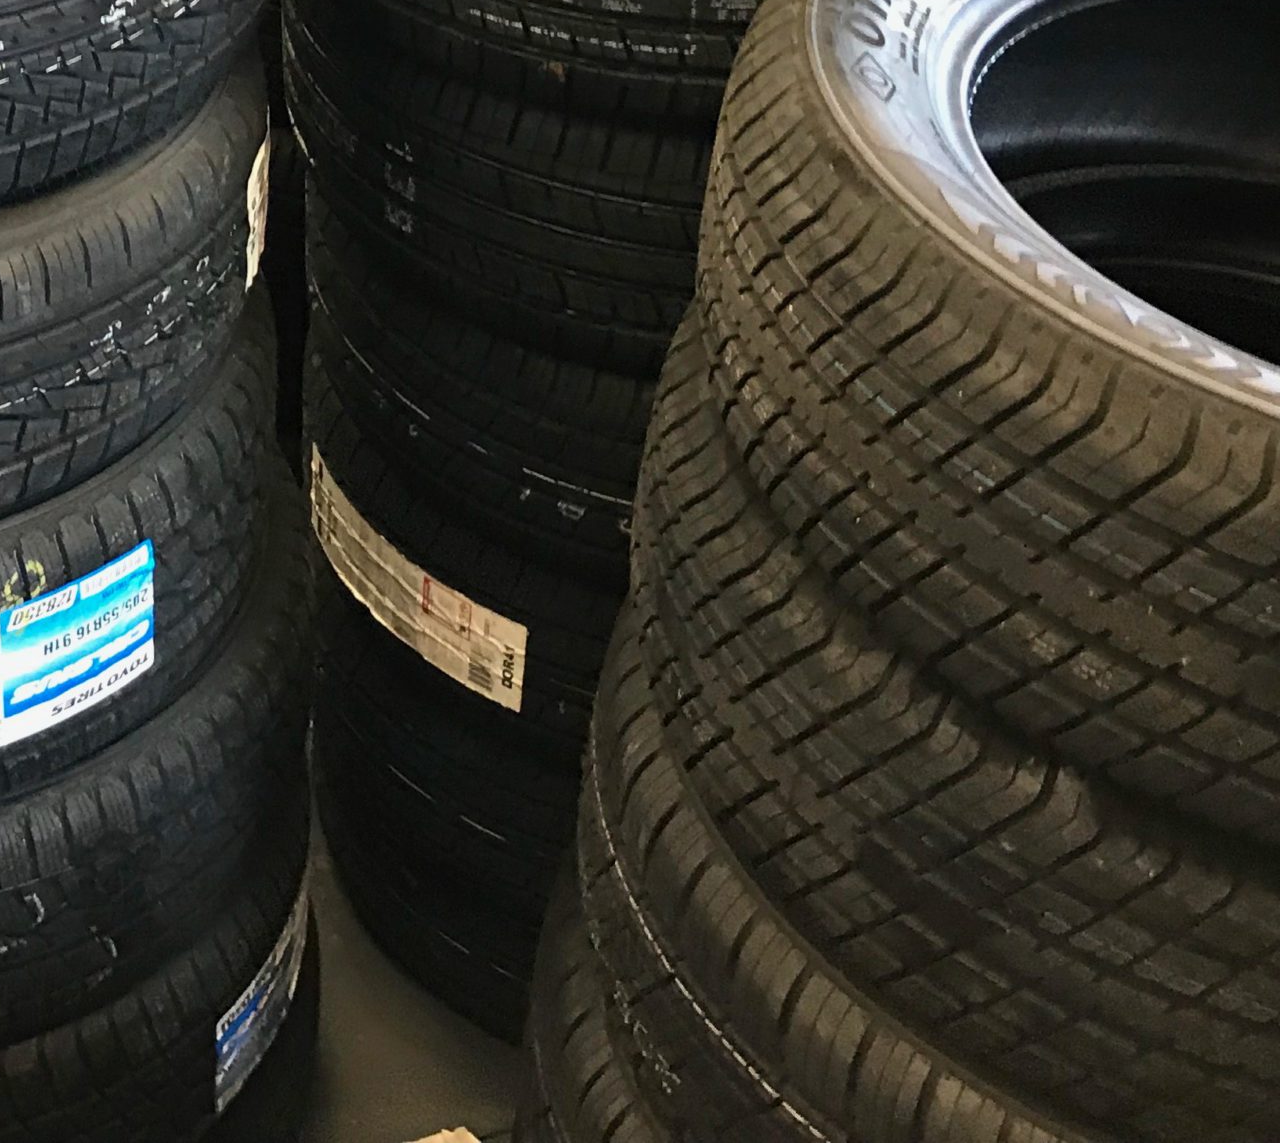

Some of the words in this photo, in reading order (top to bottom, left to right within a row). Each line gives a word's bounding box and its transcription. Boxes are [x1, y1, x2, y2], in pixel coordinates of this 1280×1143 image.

[43, 632, 72, 656] 91H
[106, 652, 149, 687] TOYO
[51, 683, 105, 717] TIRES
